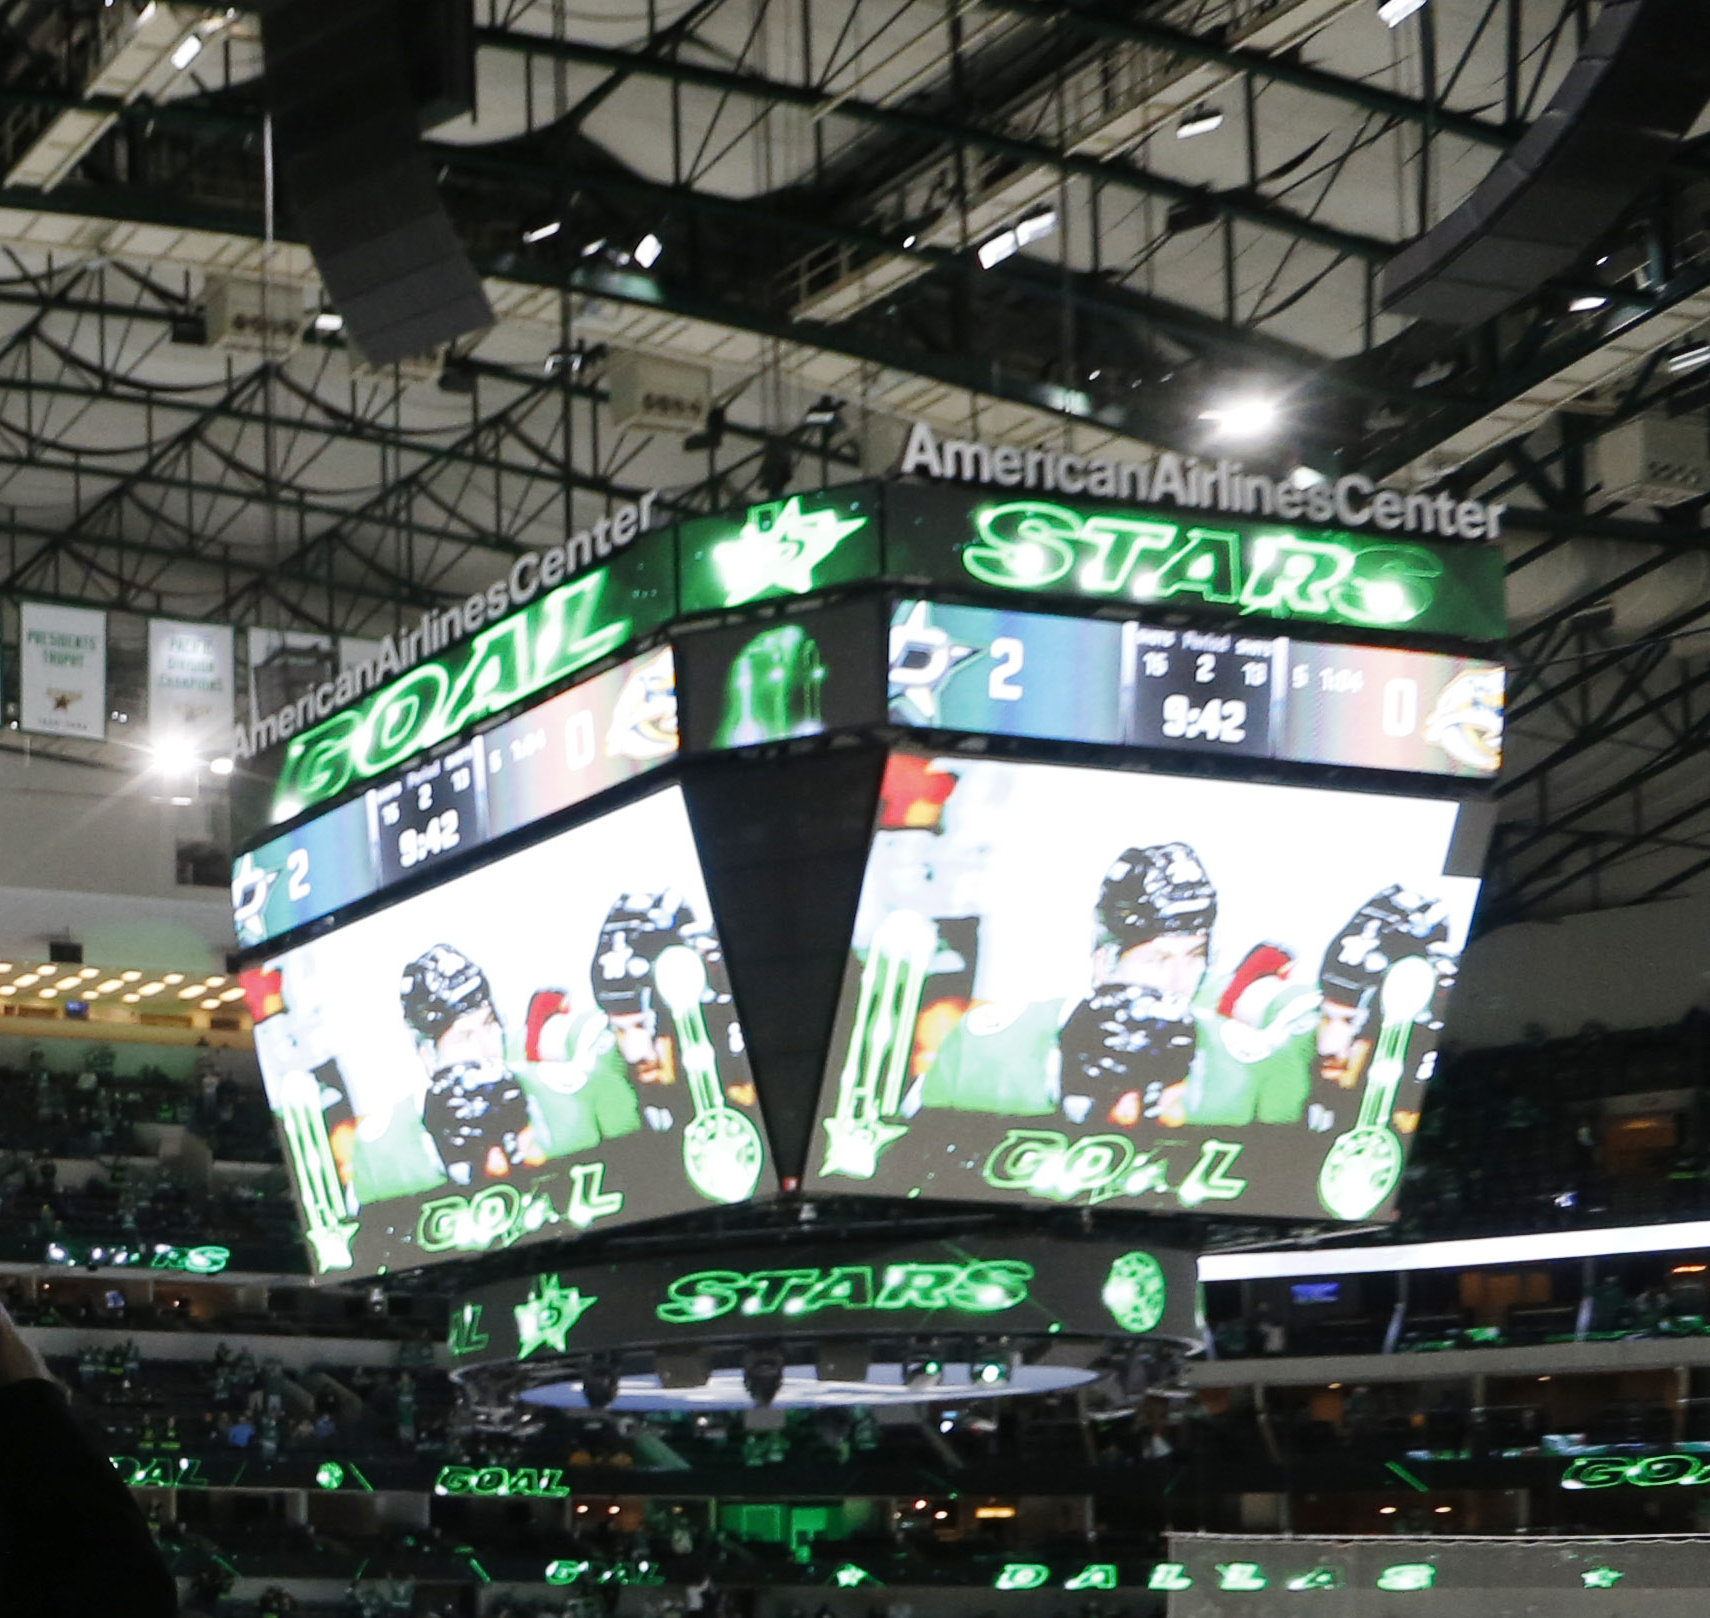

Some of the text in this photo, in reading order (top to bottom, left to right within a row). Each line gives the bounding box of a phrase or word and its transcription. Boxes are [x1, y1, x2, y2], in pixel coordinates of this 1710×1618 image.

[962, 501, 1443, 628] STARS
[270, 566, 633, 825] GOAL
[987, 638, 1025, 702] 2
[1194, 652, 1217, 684] 2
[1161, 693, 1248, 744] 9:42
[1382, 678, 1418, 738] 0
[564, 713, 595, 772] 0
[417, 782, 434, 812] 2
[397, 808, 461, 869] 9:42
[286, 847, 311, 901] 2
[656, 1260, 1036, 1324] STARS
[108, 1455, 210, 1488] OAL
[434, 1466, 571, 1497] GOAL
